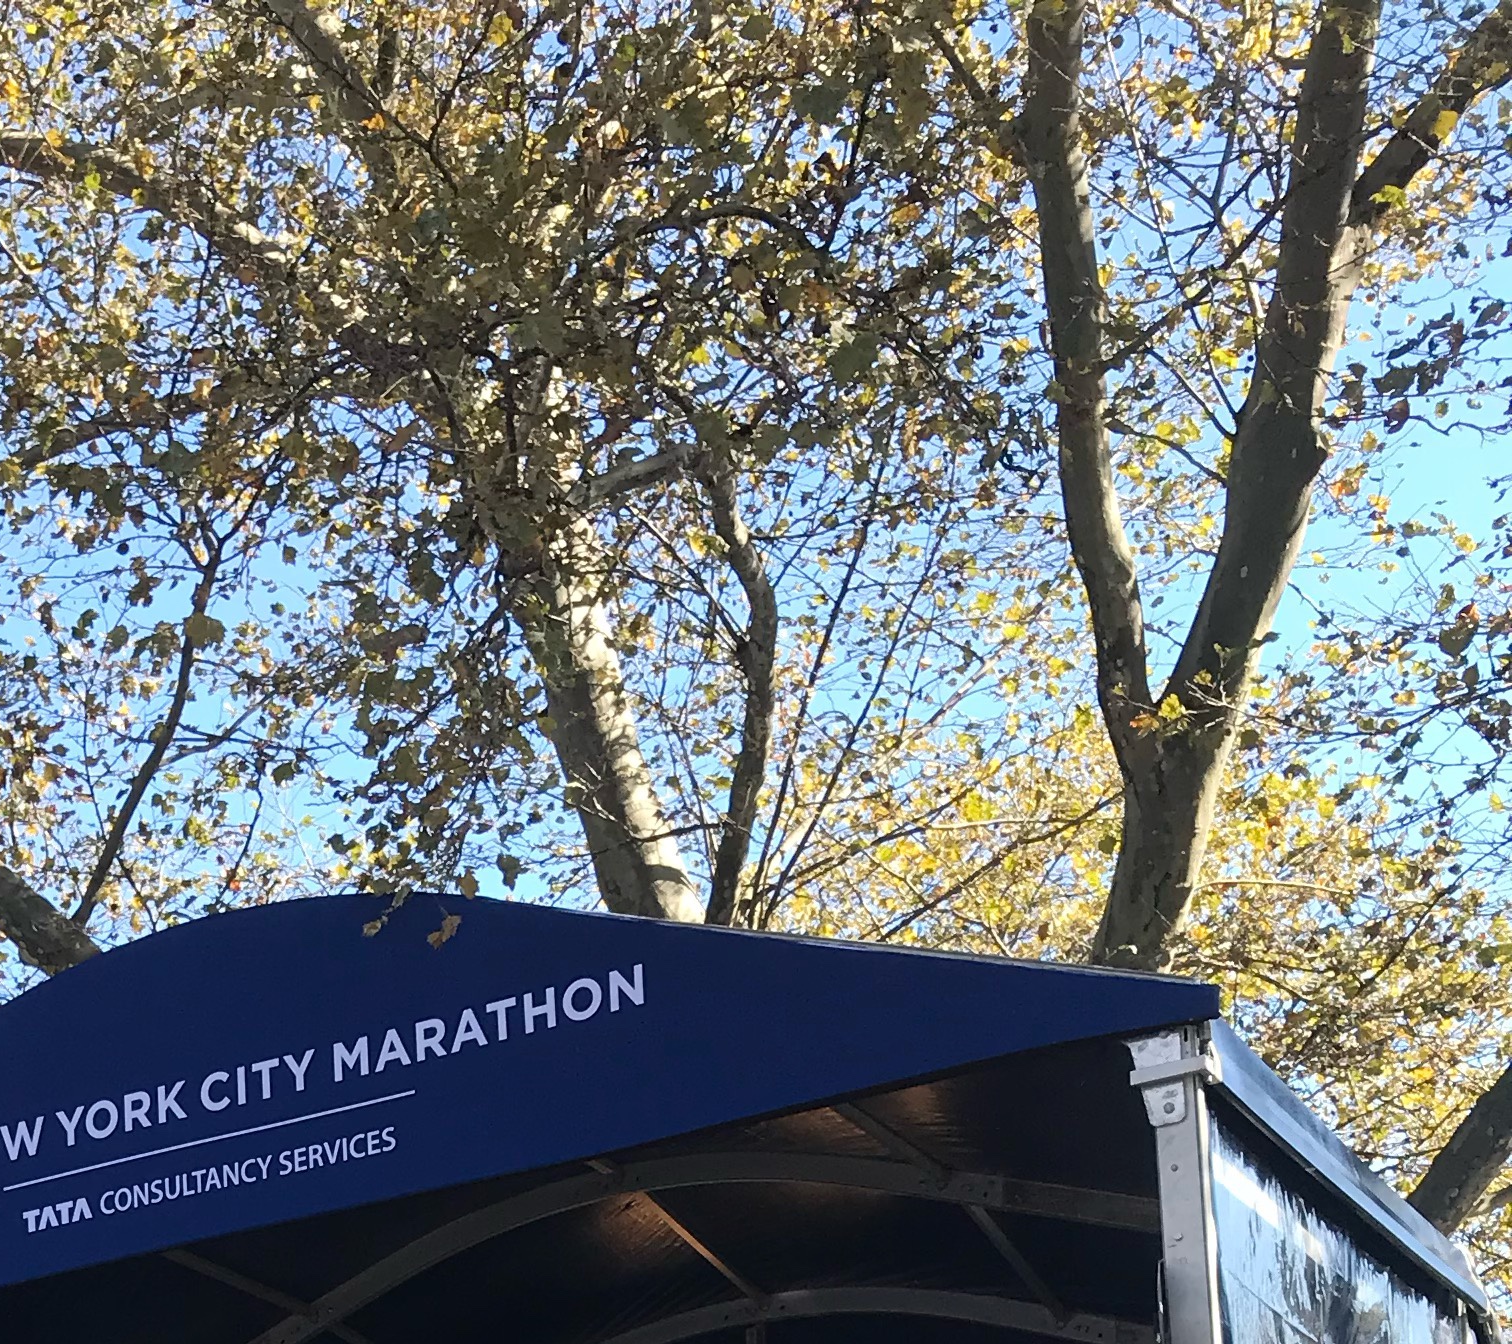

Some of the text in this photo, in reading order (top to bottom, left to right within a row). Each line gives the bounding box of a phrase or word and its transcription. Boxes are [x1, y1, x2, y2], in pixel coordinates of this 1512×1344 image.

[55, 1080, 188, 1147] YORK
[200, 1048, 316, 1112] CITY
[332, 963, 645, 1083] MARATHON
[23, 1126, 397, 1233] TATA CONSULTANCY SERVICES
